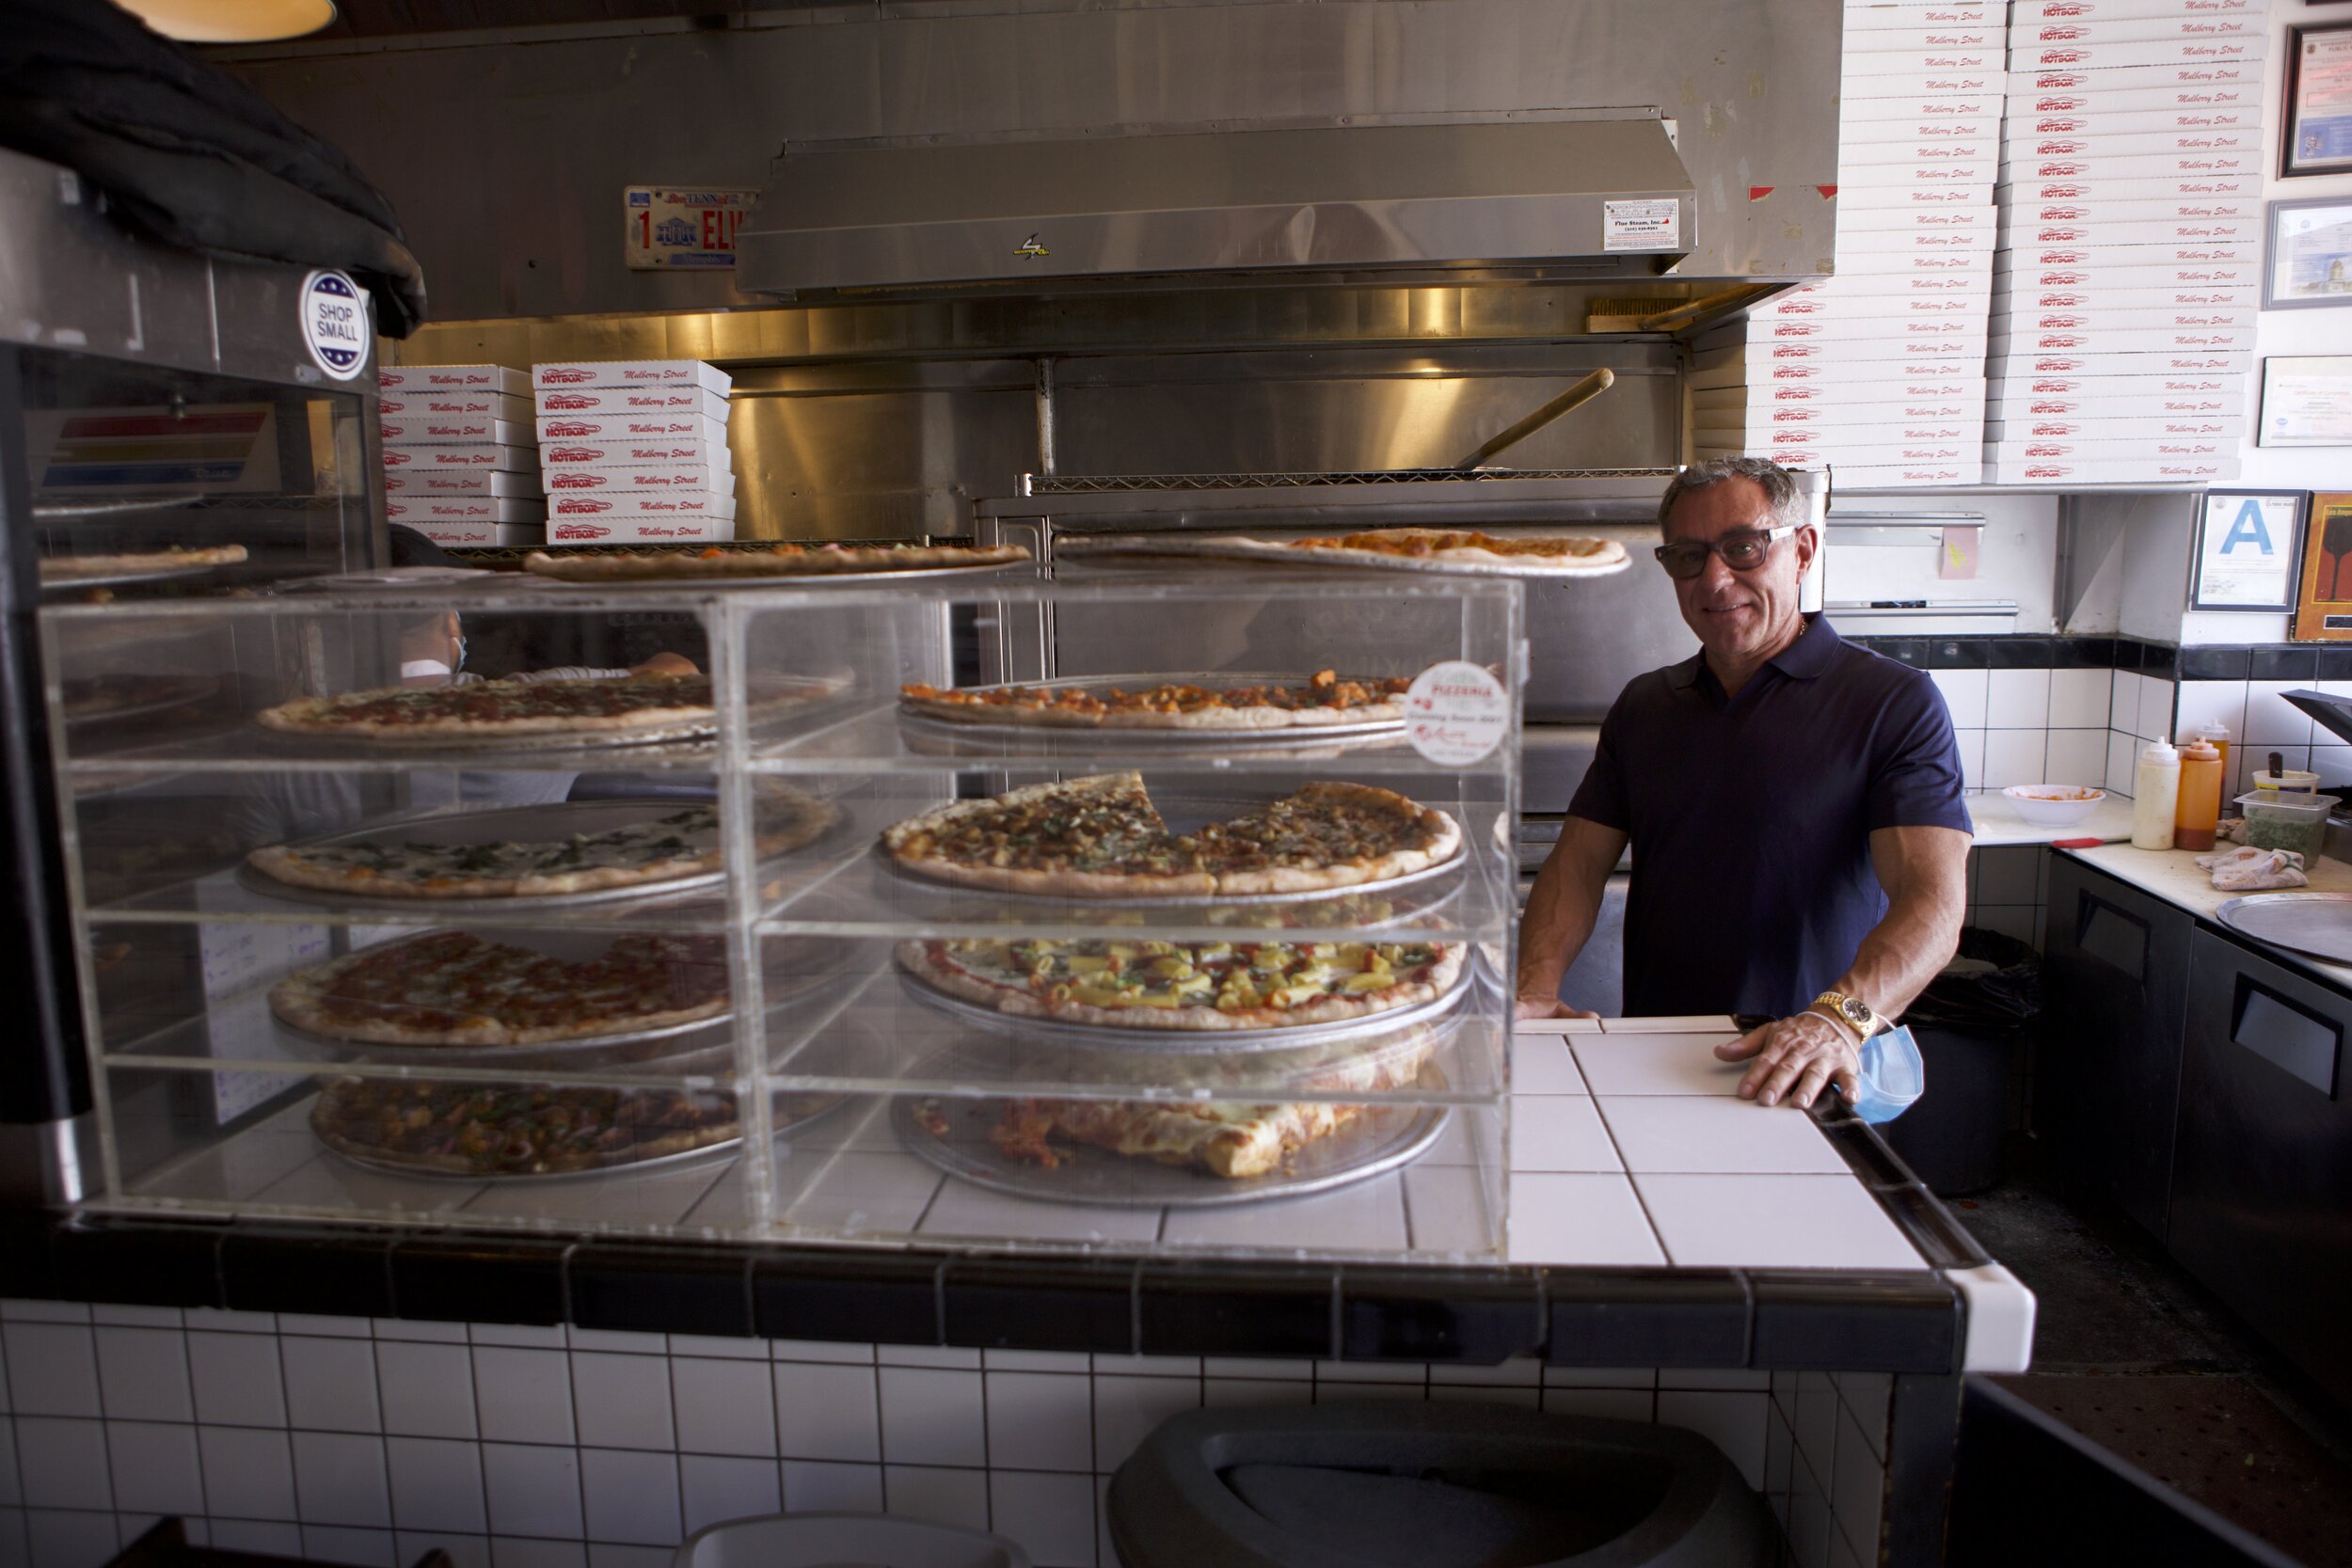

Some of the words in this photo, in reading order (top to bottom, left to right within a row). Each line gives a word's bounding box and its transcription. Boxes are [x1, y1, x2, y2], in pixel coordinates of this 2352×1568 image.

[2185, 0, 2218, 9] Mulberry
[1926, 12, 1958, 21] Mulberry
[1961, 11, 1983, 21] Street
[2181, 24, 2216, 33] Mulberry
[2218, 23, 2243, 32] Street
[1926, 36, 1958, 45] Mulberry
[2177, 71, 2212, 80] Mulberry
[2215, 70, 2239, 79] Street
[1926, 81, 1958, 90] Mulberry
[2177, 93, 2211, 103] Mulberry
[2214, 92, 2237, 102] Street
[1923, 105, 1955, 115] Mulberry
[2177, 116, 2211, 125] Mulberry
[2214, 115, 2237, 124] Street
[1918, 126, 1950, 135] Mulberry
[2177, 160, 2212, 169] Mulberry
[2215, 159, 2239, 167] Street
[1916, 170, 1948, 179] Mulberry
[1951, 169, 1974, 179] Street
[2179, 183, 2213, 193] Mulberry
[2216, 182, 2239, 192] Street
[1912, 192, 1944, 201] Mulberry
[2179, 207, 2212, 216] Mulberry
[2215, 206, 2239, 214] Street
[1916, 215, 1948, 224] Mulberry
[1951, 214, 1974, 224] Street
[639, 211, 650, 248] 1
[2177, 250, 2209, 260] Mulberry
[2212, 249, 2235, 258] Street
[1914, 259, 1946, 267] Mulberry
[1948, 258, 1972, 267] Street
[2177, 271, 2210, 280] Mulberry
[2213, 270, 2237, 278] Street
[1911, 279, 1943, 288] Mulberry
[1946, 278, 1968, 288] Street
[2175, 294, 2208, 304] Mulberry
[2211, 293, 2235, 303] Street
[1911, 302, 1943, 310] Mulberry
[1946, 301, 1968, 310] Street
[318, 303, 353, 323] SHOP
[317, 321, 358, 341] SMALL
[2175, 336, 2207, 345] Mulberry
[2210, 335, 2233, 344] Street
[1906, 344, 1938, 354] Mulberry
[2171, 359, 2204, 369] Mulberry
[2207, 358, 2232, 367] Street
[1904, 366, 1936, 374] Mulberry
[1939, 365, 1963, 374] Street
[623, 370, 660, 380] Mulberry
[662, 370, 688, 378] Street
[429, 375, 463, 386] Mulberry
[467, 375, 489, 384] Street
[628, 397, 664, 406] Mulberry
[2166, 402, 2198, 411] Mulberry
[2201, 401, 2224, 410] Street
[429, 403, 463, 413] Mulberry
[467, 403, 489, 412] Street
[1905, 408, 1937, 418] Mulberry
[427, 426, 461, 436] Mulberry
[465, 426, 487, 435] Street
[628, 424, 666, 435] Mulberry
[668, 424, 693, 433] Street
[1904, 430, 1936, 438] Mulberry
[1939, 429, 1963, 438] Street
[2166, 424, 2198, 434] Mulberry
[2201, 423, 2224, 433] Street
[630, 449, 668, 459] Mulberry
[670, 449, 695, 457] Street
[436, 454, 470, 465] Mulberry
[472, 454, 496, 463] Street
[1902, 471, 1934, 480] Mulberry
[1937, 470, 1961, 480] Street
[2160, 467, 2192, 476] Mulberry
[2195, 466, 2218, 474] Street
[427, 481, 458, 489] Mulberry
[634, 476, 670, 485] Mulberry
[431, 506, 465, 516] Mulberry
[469, 506, 491, 515] Street
[640, 501, 675, 512] Mulberry
[679, 501, 704, 510] Street
[638, 527, 674, 536] Mulberry
[2218, 499, 2274, 555] A
[427, 531, 461, 542] Mulberry
[465, 531, 487, 540] Street
